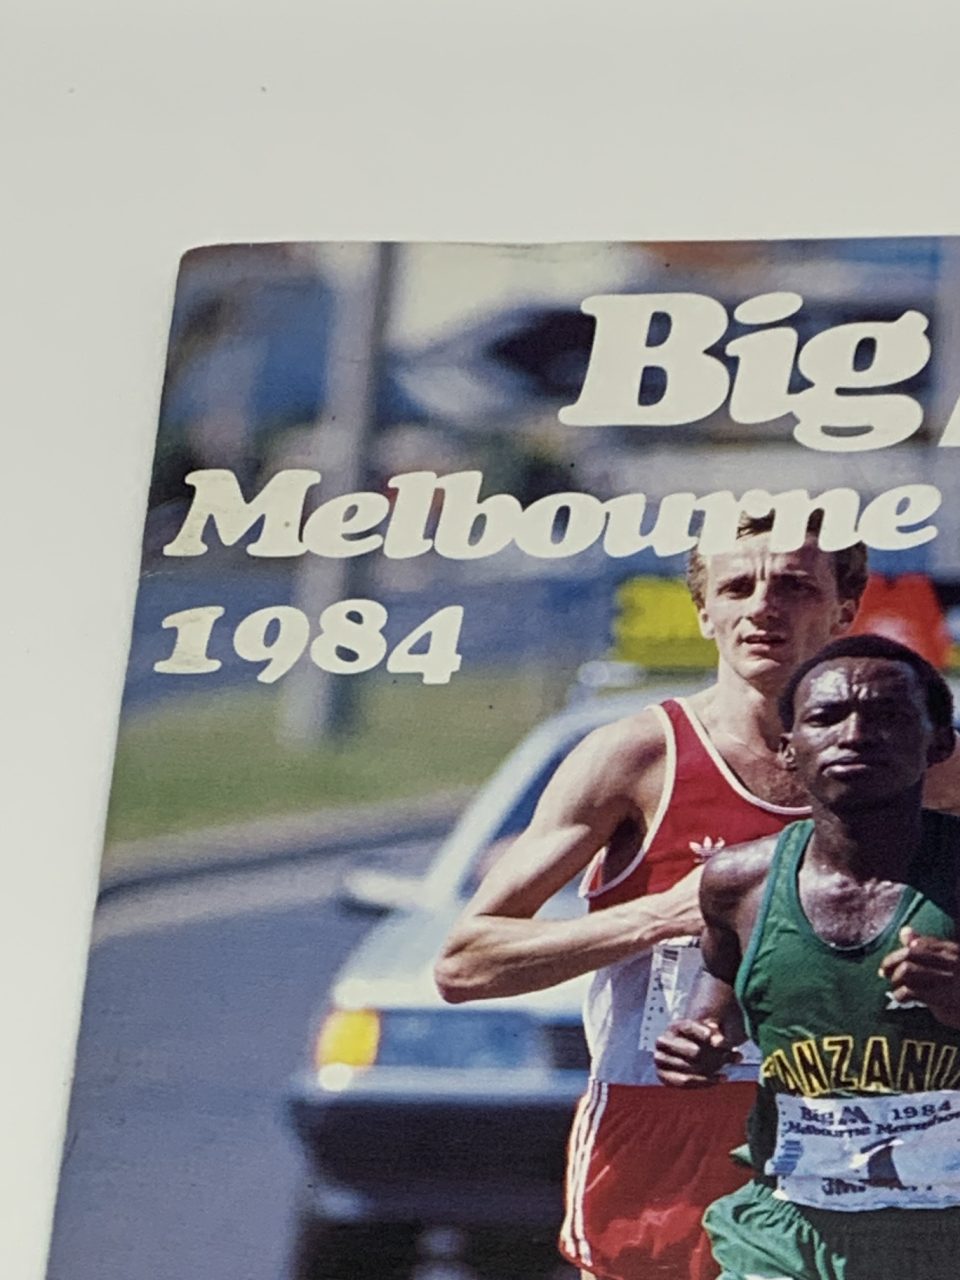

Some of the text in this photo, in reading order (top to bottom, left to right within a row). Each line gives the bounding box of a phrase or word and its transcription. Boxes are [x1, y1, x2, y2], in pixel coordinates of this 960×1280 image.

[558, 291, 931, 452] Big
[162, 468, 942, 560] Melbourne
[153, 599, 464, 686] 1984
[892, 1100, 952, 1121] 1984
